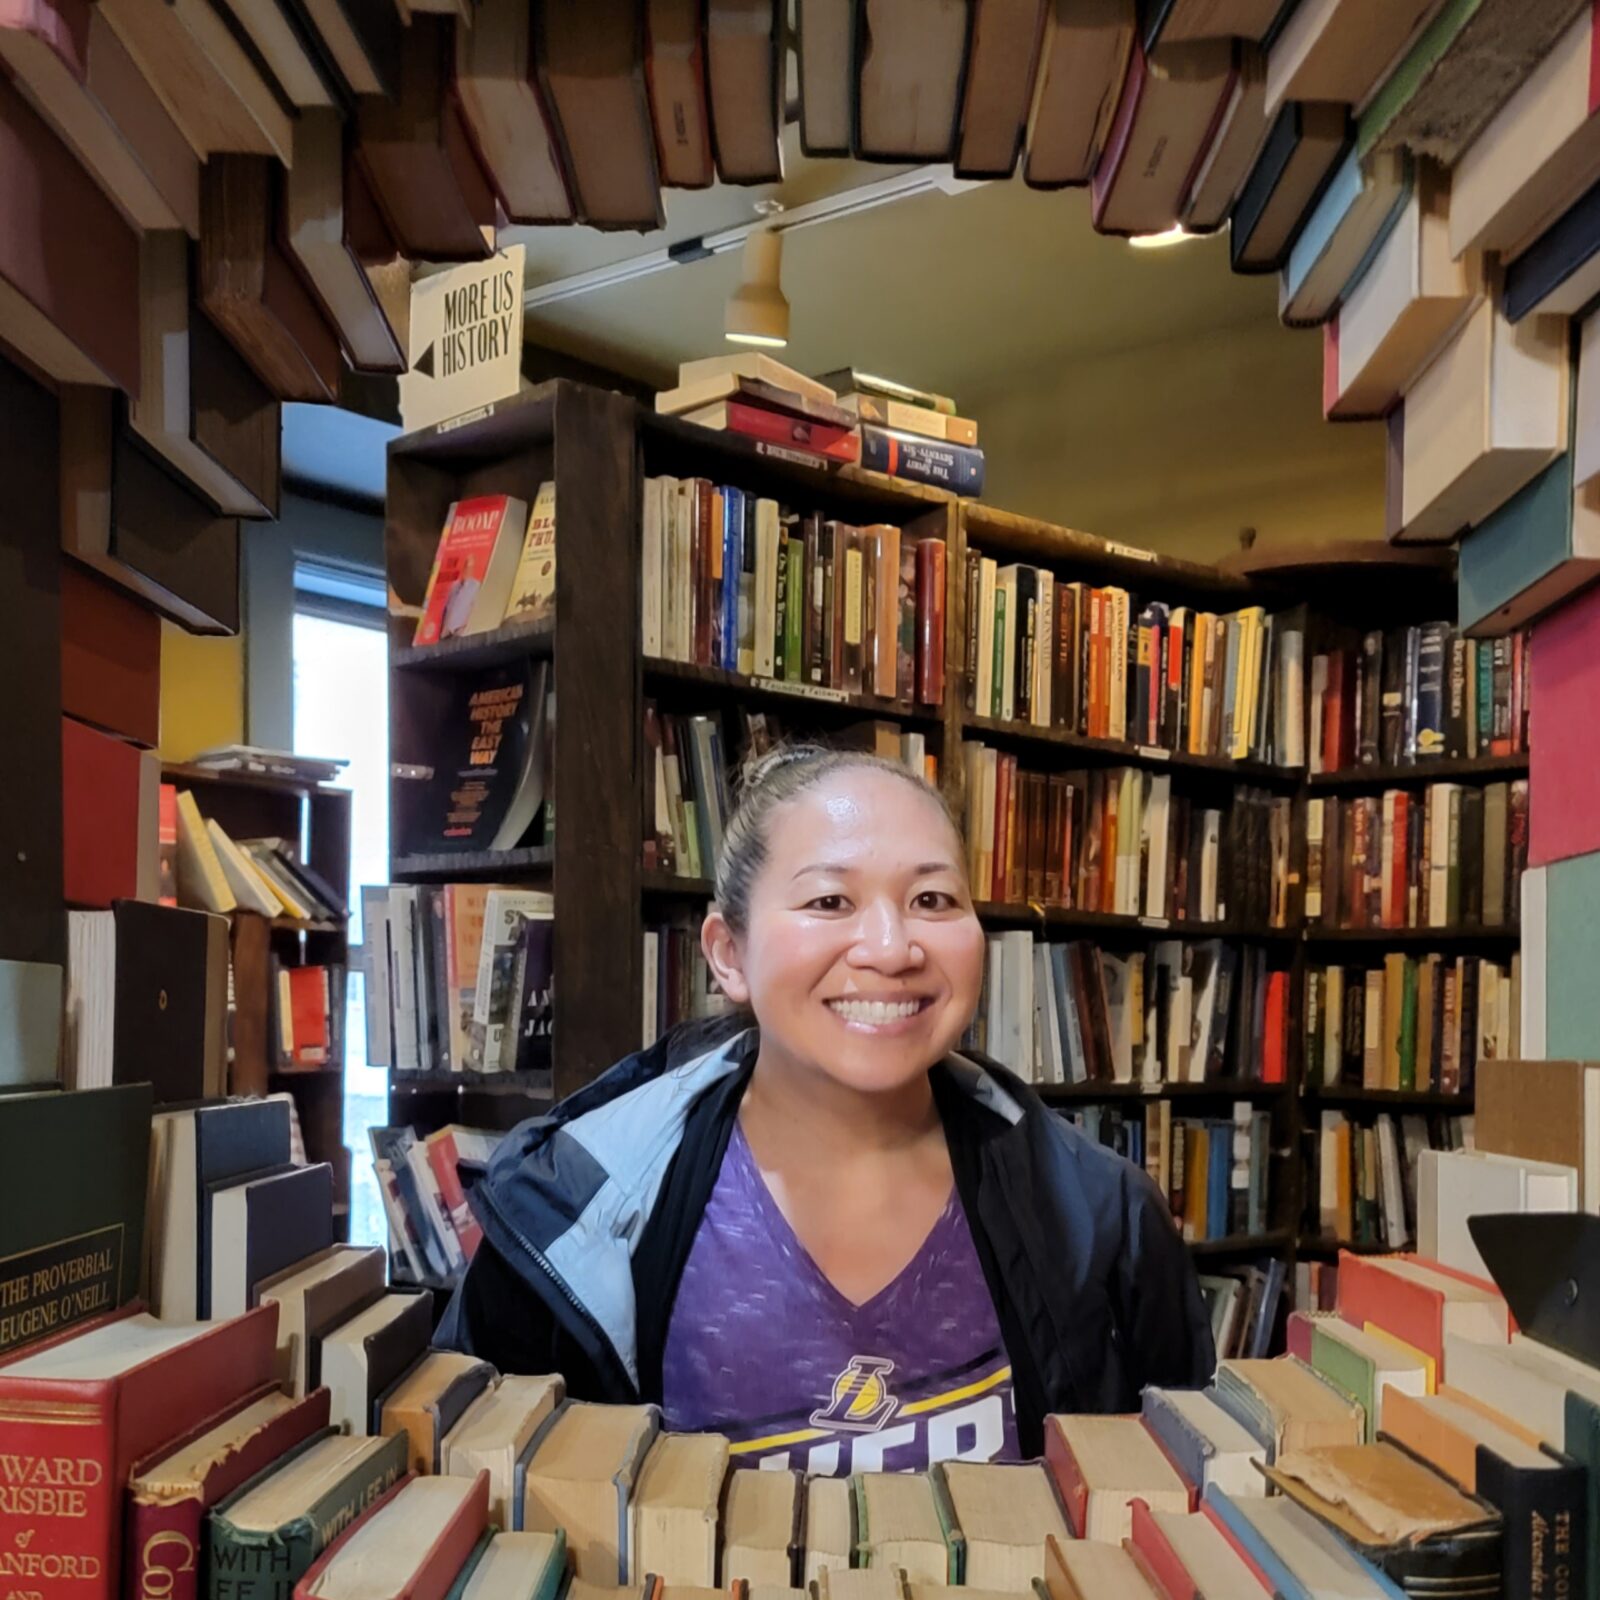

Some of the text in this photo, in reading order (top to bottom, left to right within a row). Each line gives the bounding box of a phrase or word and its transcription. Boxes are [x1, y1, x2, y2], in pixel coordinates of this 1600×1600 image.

[444, 270, 514, 334] MORE US
[442, 312, 513, 378] HISTORY
[1116, 596, 1125, 683] WASHINGTON
[468, 684, 524, 707] AMERICAN
[470, 702, 518, 721] HISTORY
[471, 734, 503, 750] EAST
[481, 720, 503, 735] THE
[0, 1248, 113, 1308] THE PROVERBIAL
[0, 1280, 111, 1345] EUGENE O'NEILL
[15, 1529, 36, 1549] of
[213, 1545, 291, 1573] WITH
[1554, 1564, 1570, 1600] CO
